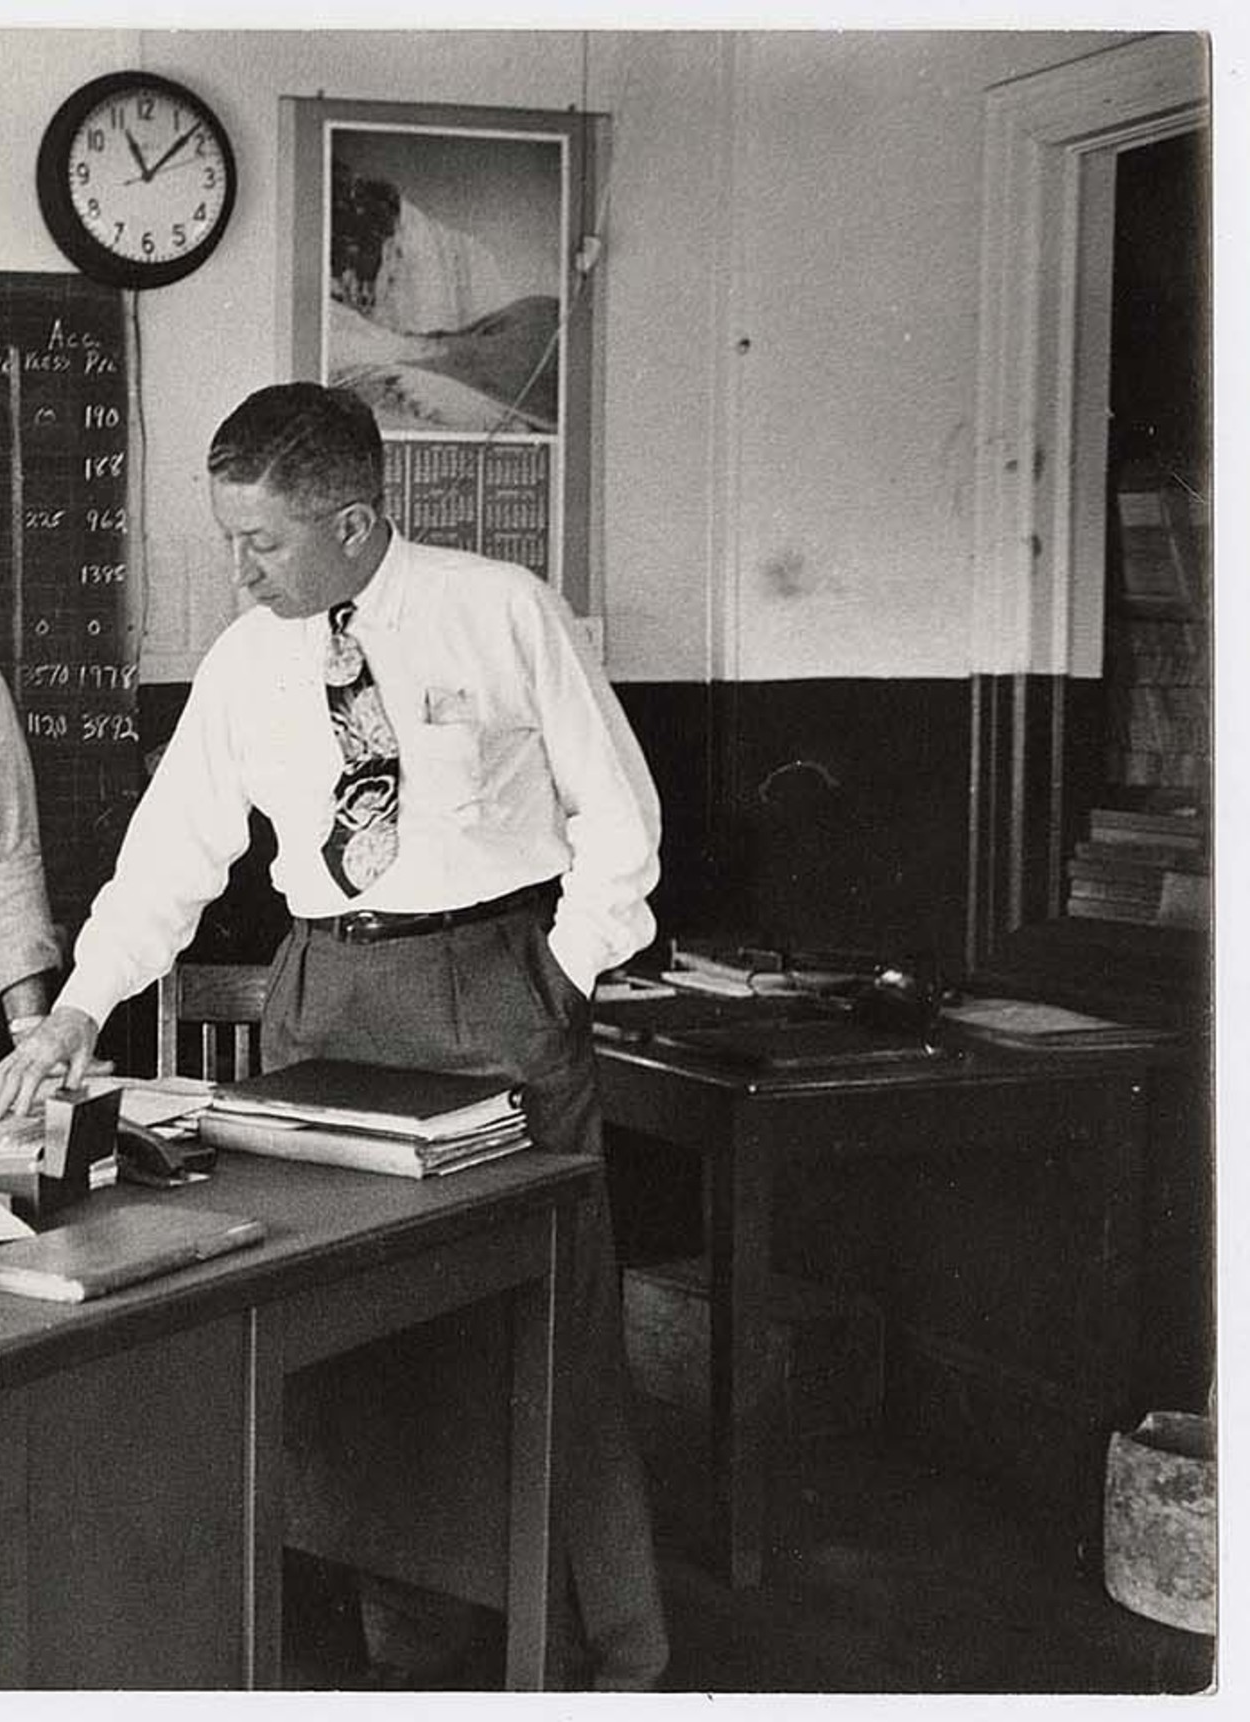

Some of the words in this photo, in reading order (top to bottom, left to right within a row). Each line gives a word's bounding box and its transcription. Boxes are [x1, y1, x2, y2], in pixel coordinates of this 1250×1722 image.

[111, 107, 125, 130] 11
[137, 99, 155, 121] 12
[173, 109, 180, 133] 1
[87, 128, 105, 153] 10
[195, 133, 207, 157] 2
[76, 162, 90, 185] 9
[203, 167, 217, 189] 3
[87, 198, 101, 219] 8
[193, 202, 207, 222] 4
[113, 222, 125, 243] 7
[141, 232, 155, 254] 6
[172, 223, 186, 247] 5
